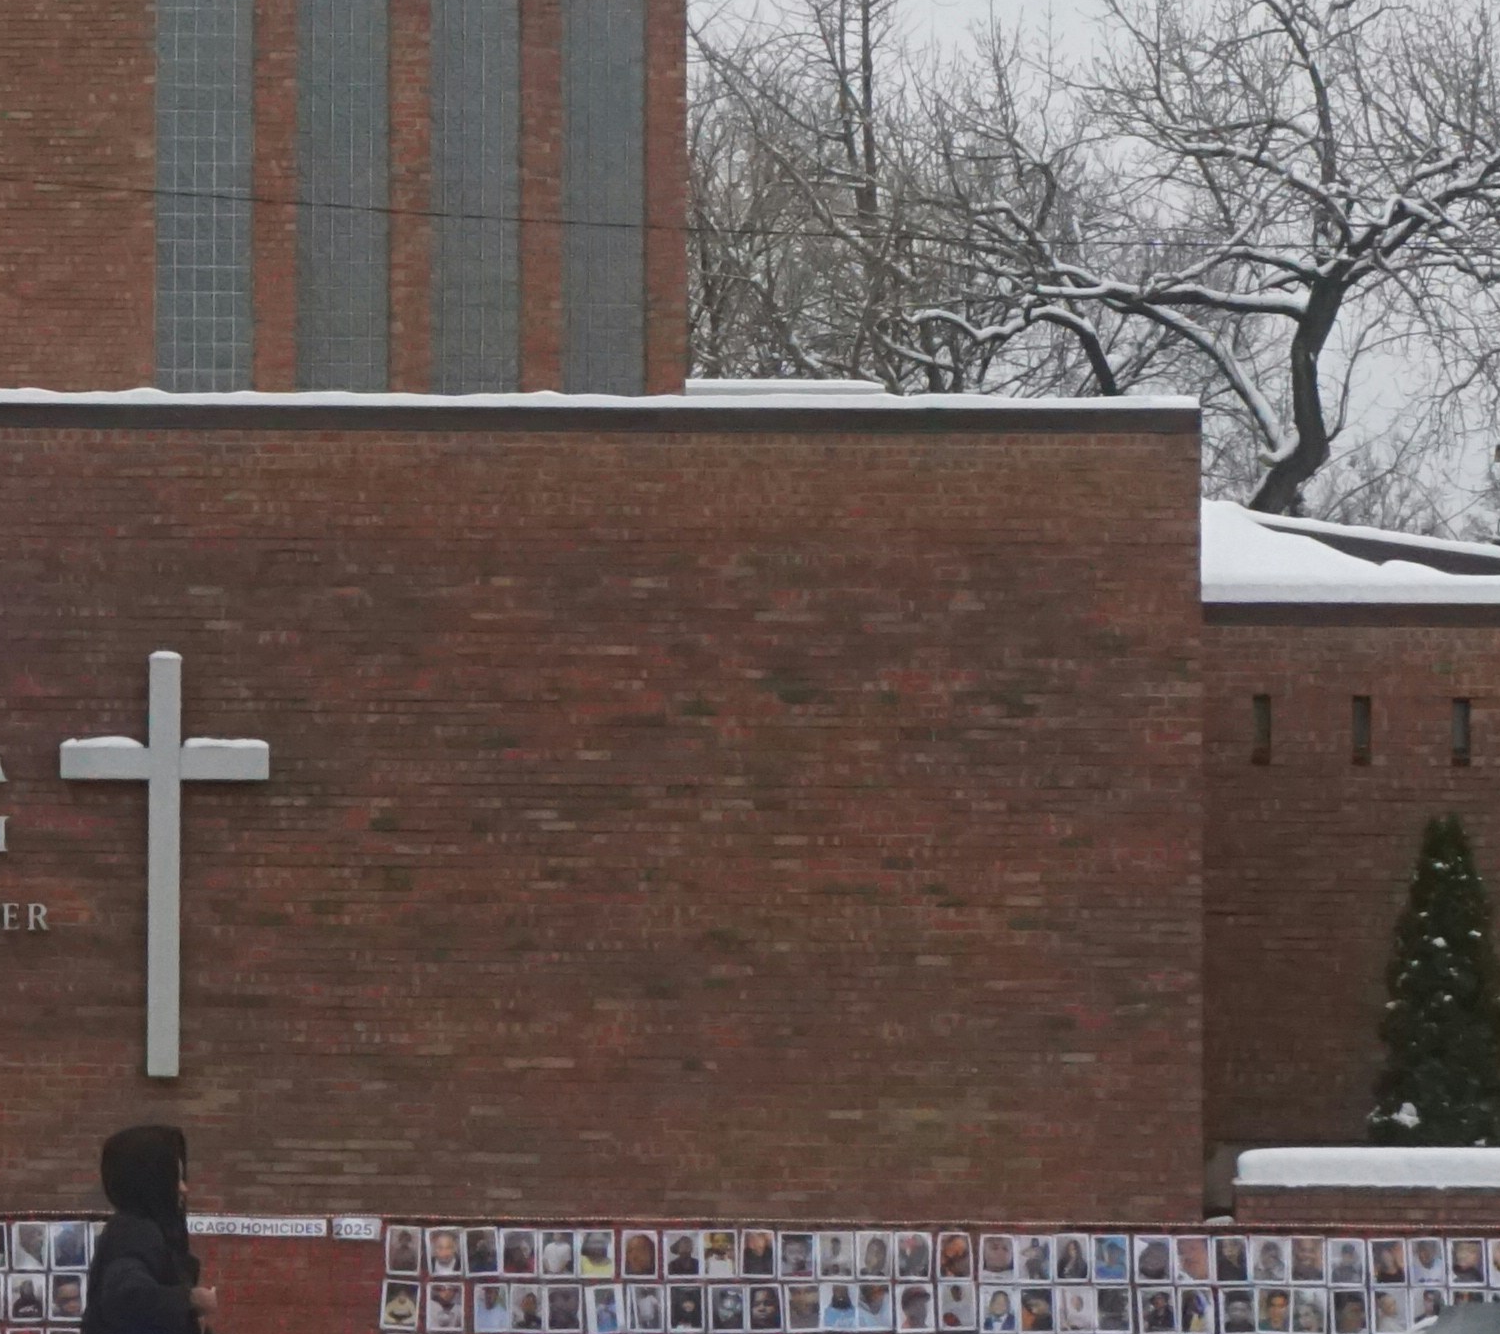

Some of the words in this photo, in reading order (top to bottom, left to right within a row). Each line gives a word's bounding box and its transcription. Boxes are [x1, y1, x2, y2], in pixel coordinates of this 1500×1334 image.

[187, 1220, 237, 1234] ICAGO
[240, 1221, 324, 1235] HOMICIDES
[334, 1222, 373, 1237] 2025
